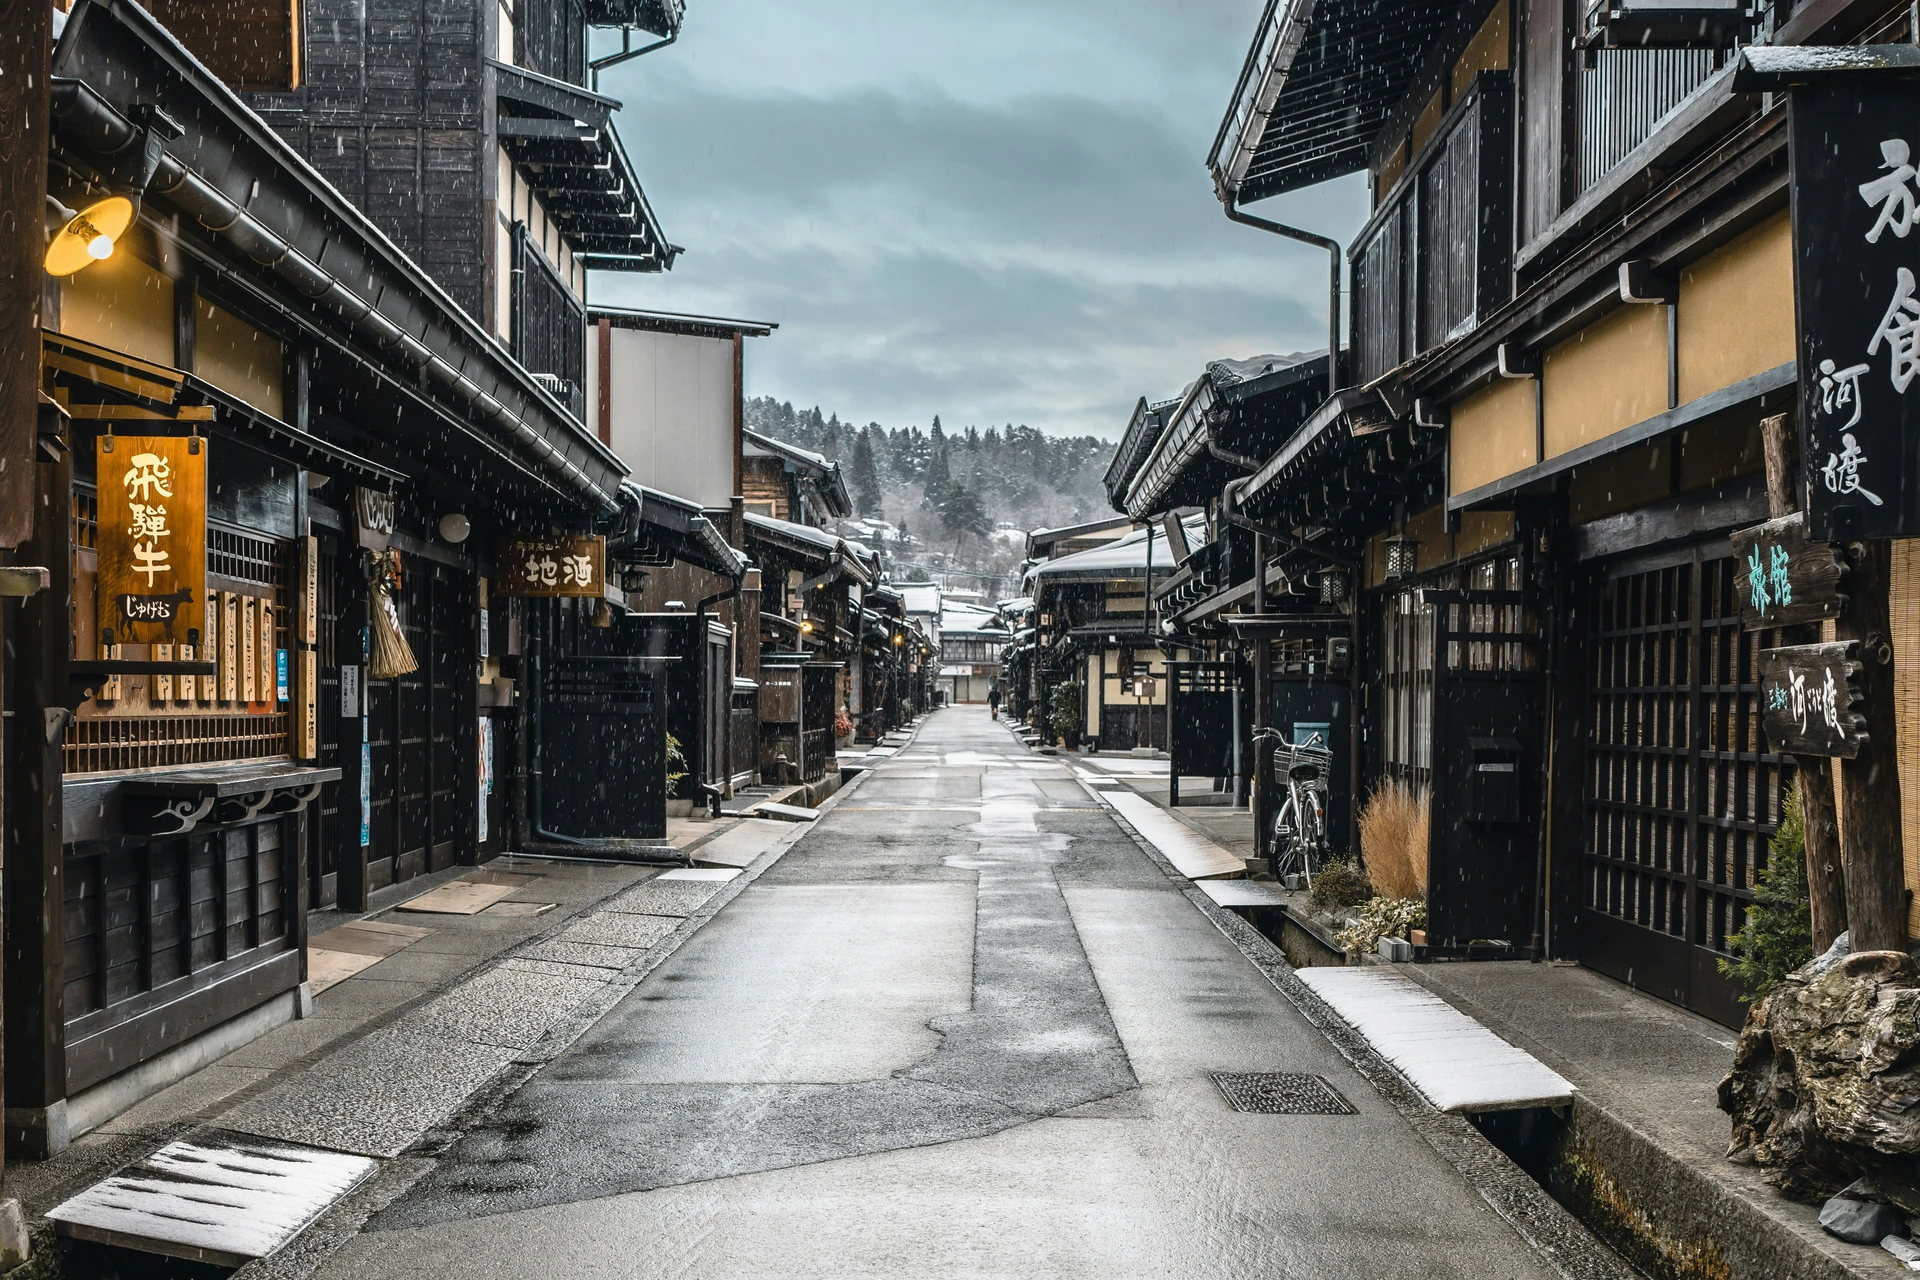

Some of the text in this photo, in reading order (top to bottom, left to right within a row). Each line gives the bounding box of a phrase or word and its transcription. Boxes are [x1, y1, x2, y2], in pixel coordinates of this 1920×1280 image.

[525, 554, 593, 587] 地酒
[1748, 543, 1792, 618] 旅館
[126, 595, 171, 619] じゅげむ
